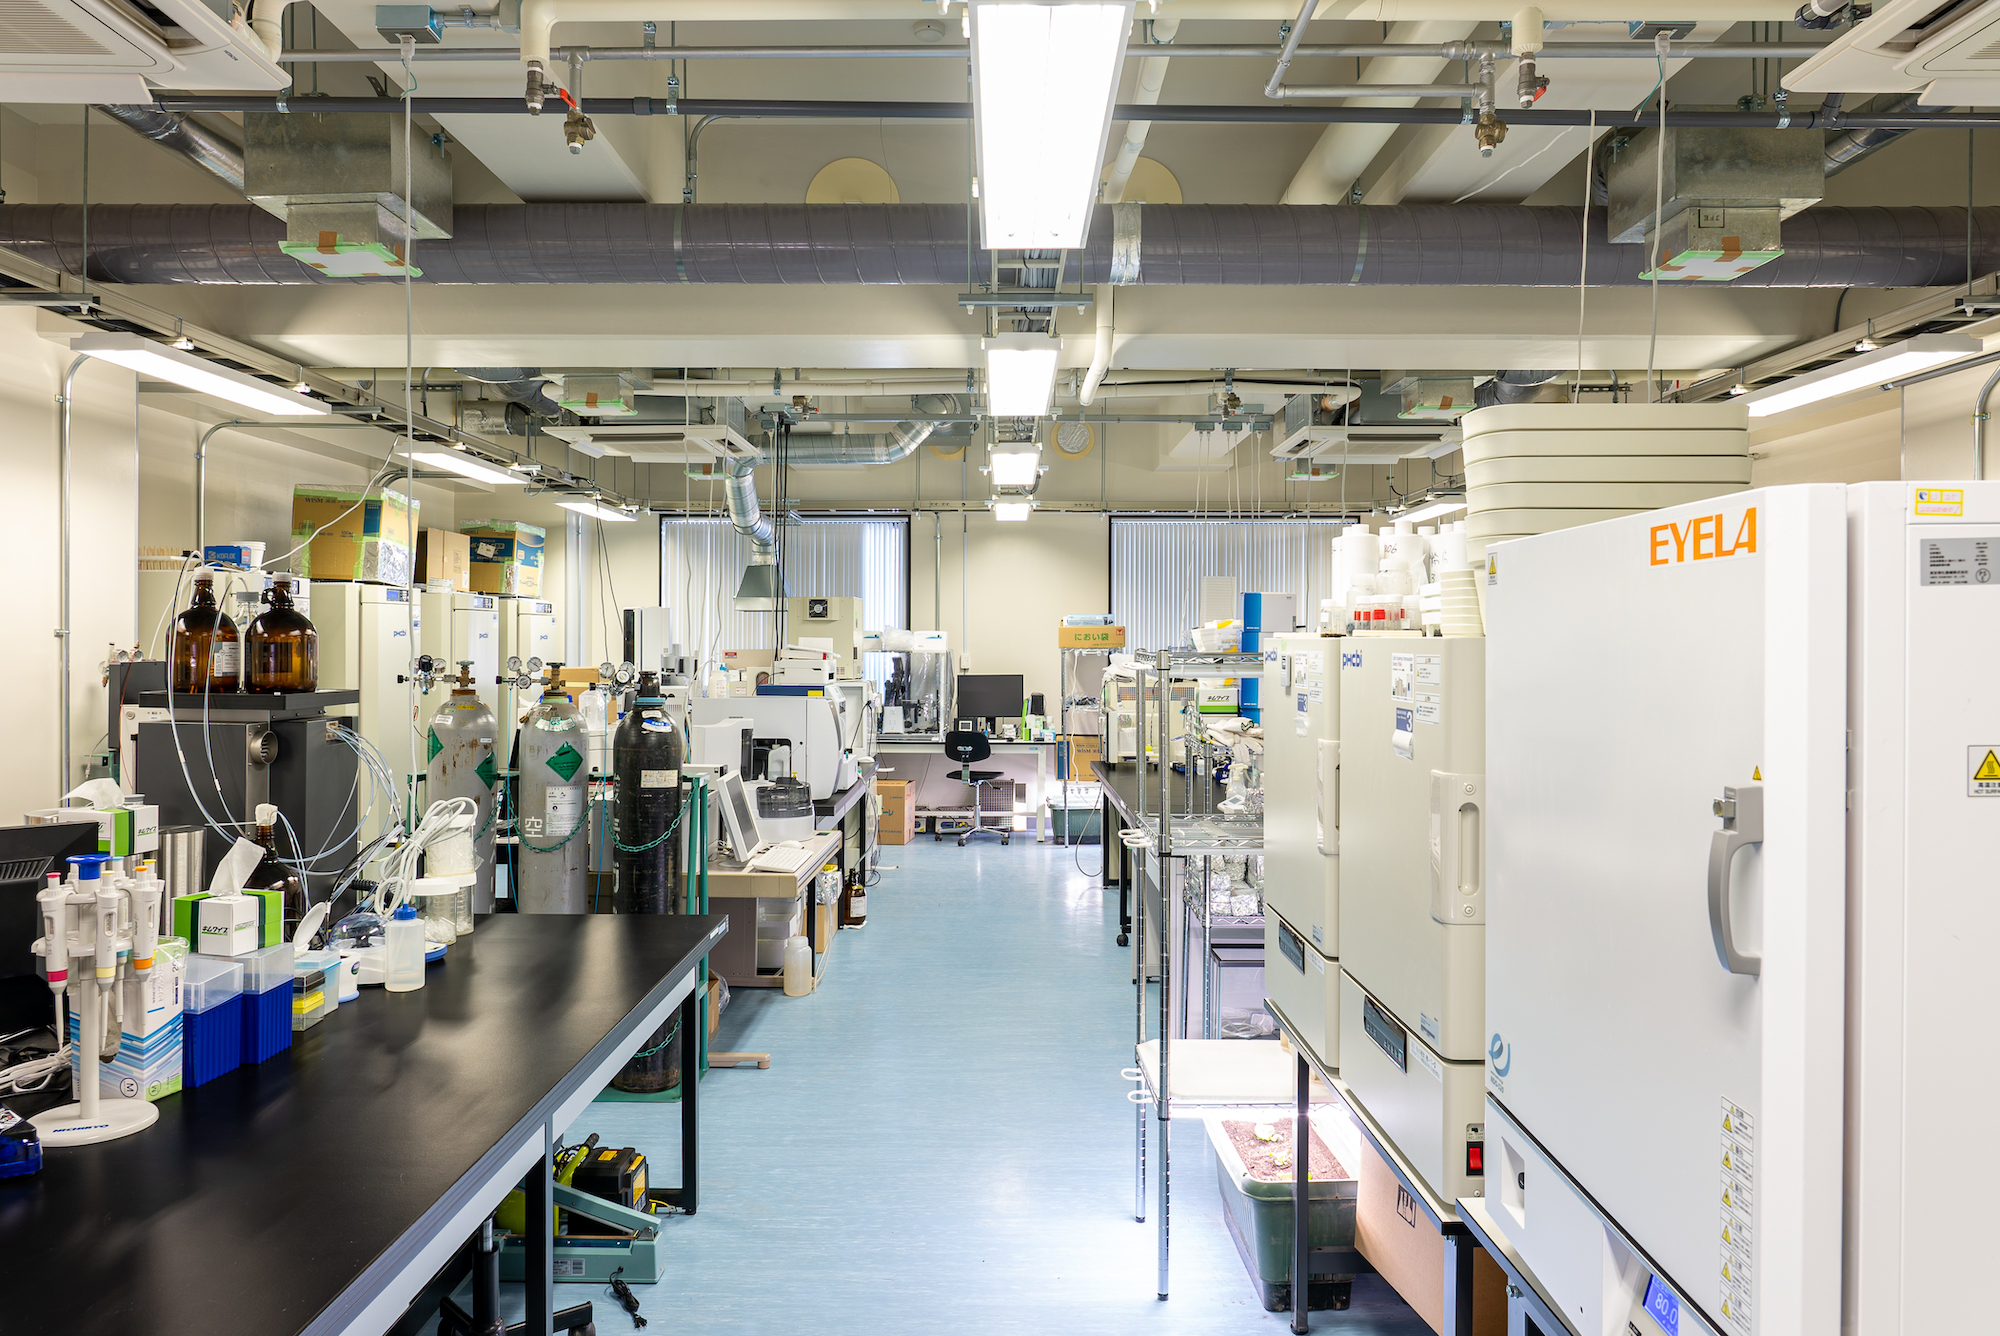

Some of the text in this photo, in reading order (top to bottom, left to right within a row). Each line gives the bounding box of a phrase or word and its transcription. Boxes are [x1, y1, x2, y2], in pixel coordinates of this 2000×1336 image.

[1650, 507, 1757, 566] EYELA
[1074, 632, 1109, 641] におい袋
[1406, 711, 1413, 732] 3
[524, 816, 543, 838] 空
[1655, 1292, 1678, 1325] 80.0
